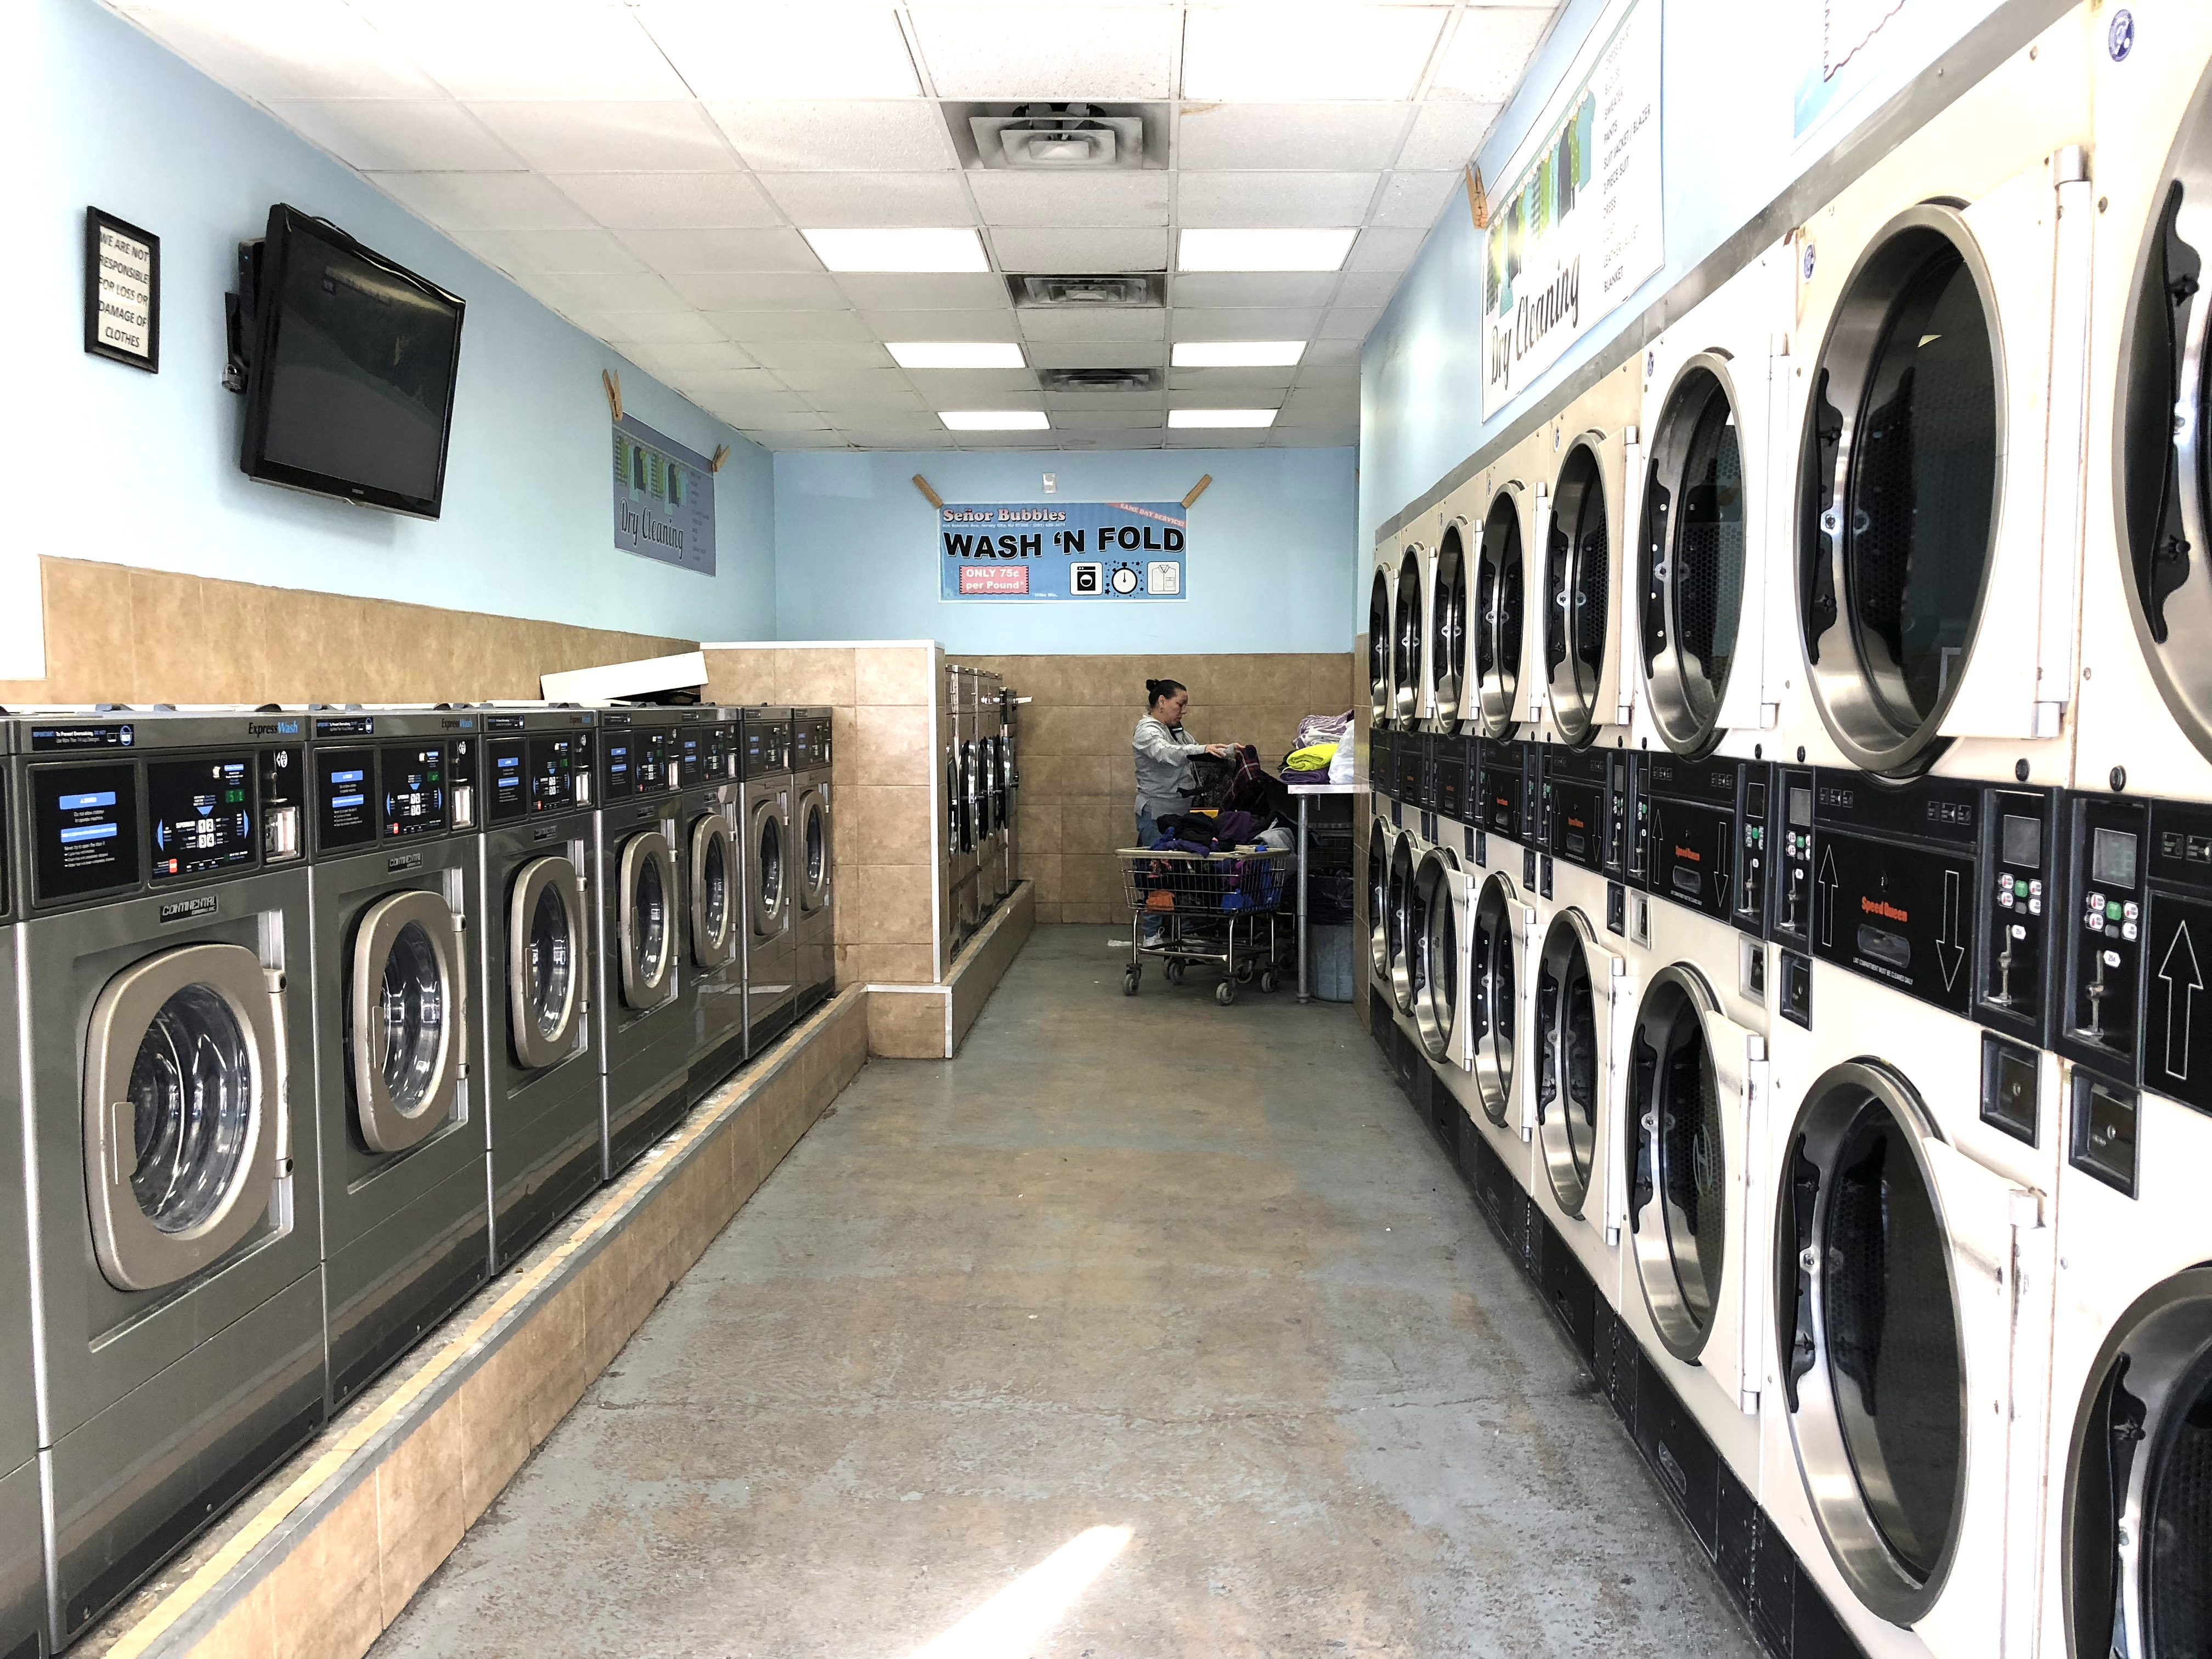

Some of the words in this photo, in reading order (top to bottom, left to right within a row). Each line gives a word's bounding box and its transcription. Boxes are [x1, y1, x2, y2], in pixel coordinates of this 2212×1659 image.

[1604, 87, 1623, 120] SWEATER
[1604, 120, 1617, 145] PANTS
[1604, 150, 1613, 170] SUIT
[1613, 129, 1629, 159] JACKET
[1633, 104, 1651, 134] BLAZER
[1604, 168, 1618, 195] 2-PIECE
[1620, 155, 1629, 176] SUIT
[100, 232, 113, 247] WE
[114, 239, 131, 255] ARE
[132, 246, 150, 263] NOT
[100, 254, 150, 285] RESPONSIBLE
[1604, 266, 1623, 292] BLANKET
[99, 276, 115, 293] FOR
[116, 284, 135, 300] LOSS
[137, 292, 148, 307] OR
[99, 300, 135, 324] DAMAGE
[137, 315, 148, 328] OF
[1491, 325, 1512, 391] Dry
[1516, 254, 1580, 361] Cleaning
[105, 326, 140, 348] CLOTHES
[943, 508, 994, 522] Señor
[997, 508, 1066, 522] Bubbles
[1120, 503, 1139, 514] SAME
[1139, 509, 1154, 517] DAY
[1154, 513, 1185, 527] SERVICE!
[620, 498, 639, 546] Dry
[642, 506, 684, 560] Cleaning
[943, 532, 1042, 559] WASH
[1097, 525, 1185, 552] FOLD
[966, 569, 996, 578] ONLY
[966, 582, 983, 591] per
[248, 720, 298, 738] ExpressWash
[442, 718, 473, 730] ExpressWash
[162, 896, 216, 916] CONTINENTAL
[1861, 896, 1884, 915] Speed
[1884, 902, 1908, 922] Queen
[1859, 958, 1879, 972] COMPARTMENT
[1878, 966, 1887, 975] MUST
[1891, 971, 1905, 982] CLEANED
